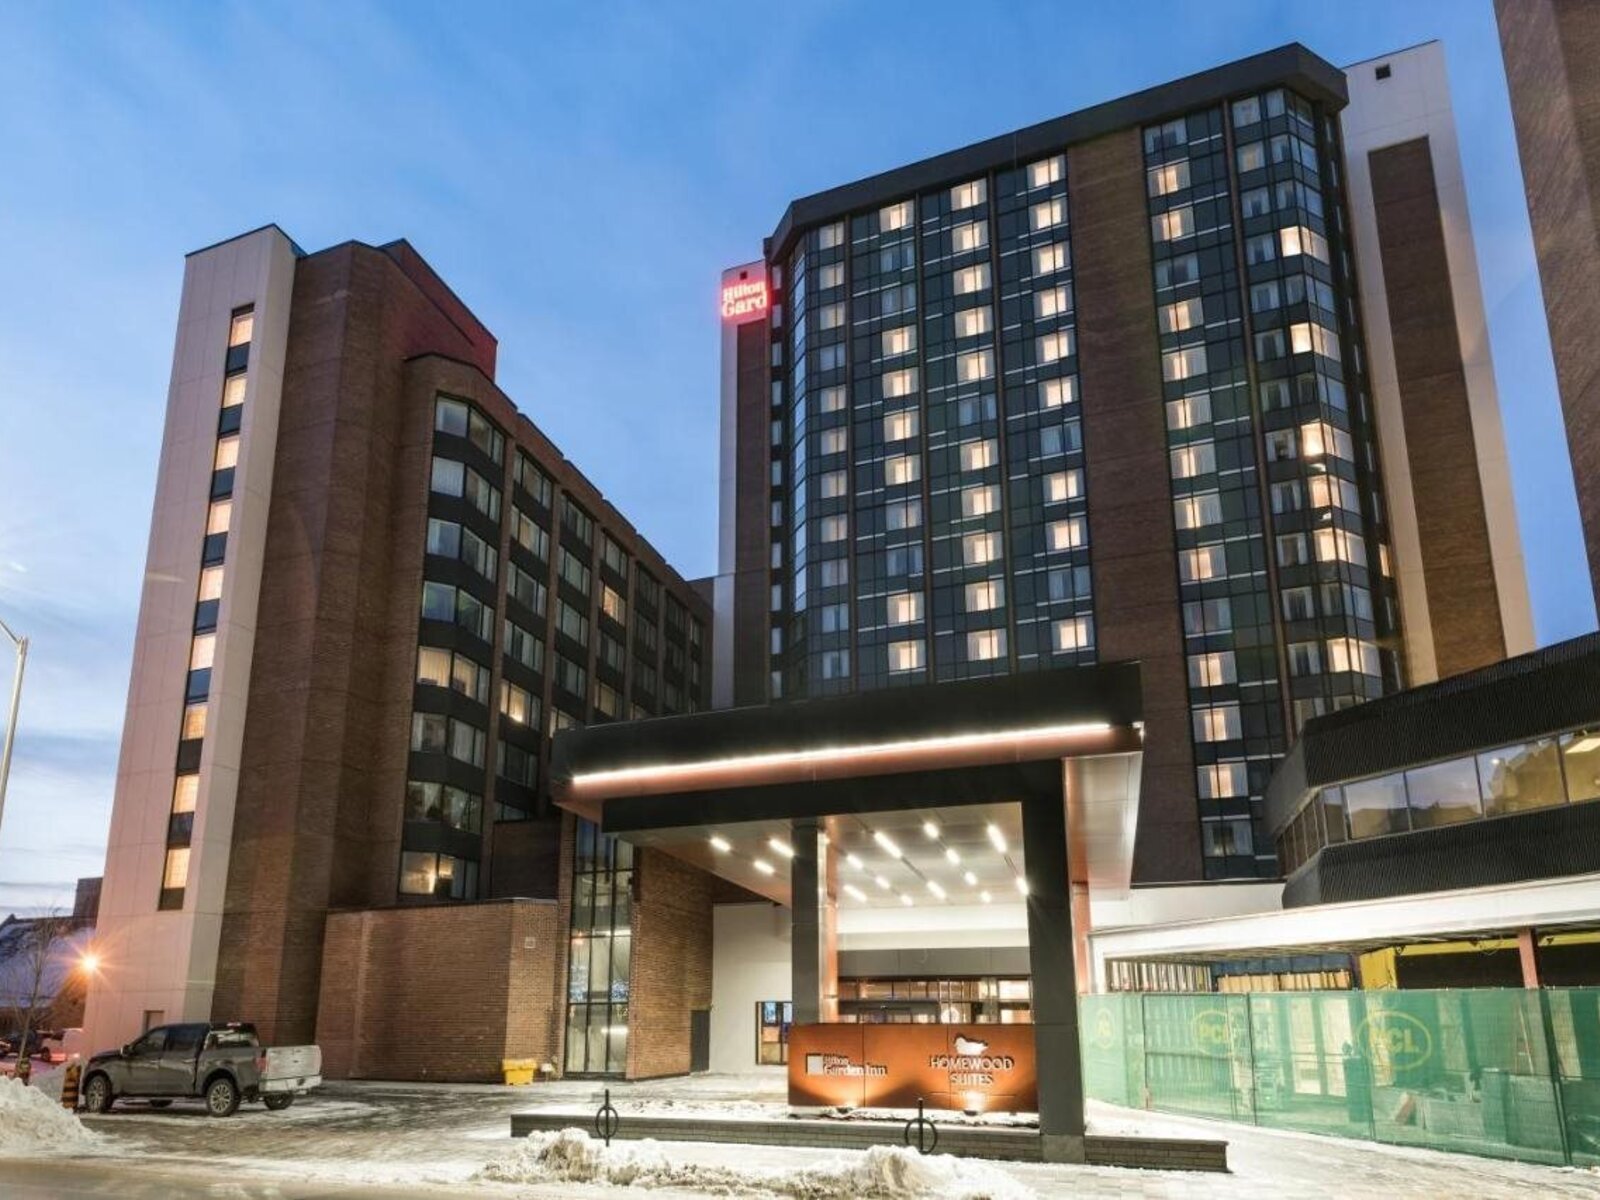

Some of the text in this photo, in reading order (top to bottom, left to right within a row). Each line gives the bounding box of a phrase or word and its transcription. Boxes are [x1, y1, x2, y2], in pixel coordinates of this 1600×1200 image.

[723, 281, 766, 300] Hilton
[824, 1063, 888, 1077] Garden Inn
[929, 1055, 1014, 1071] HOMEWOOD
[950, 1071, 993, 1086] SUITES
